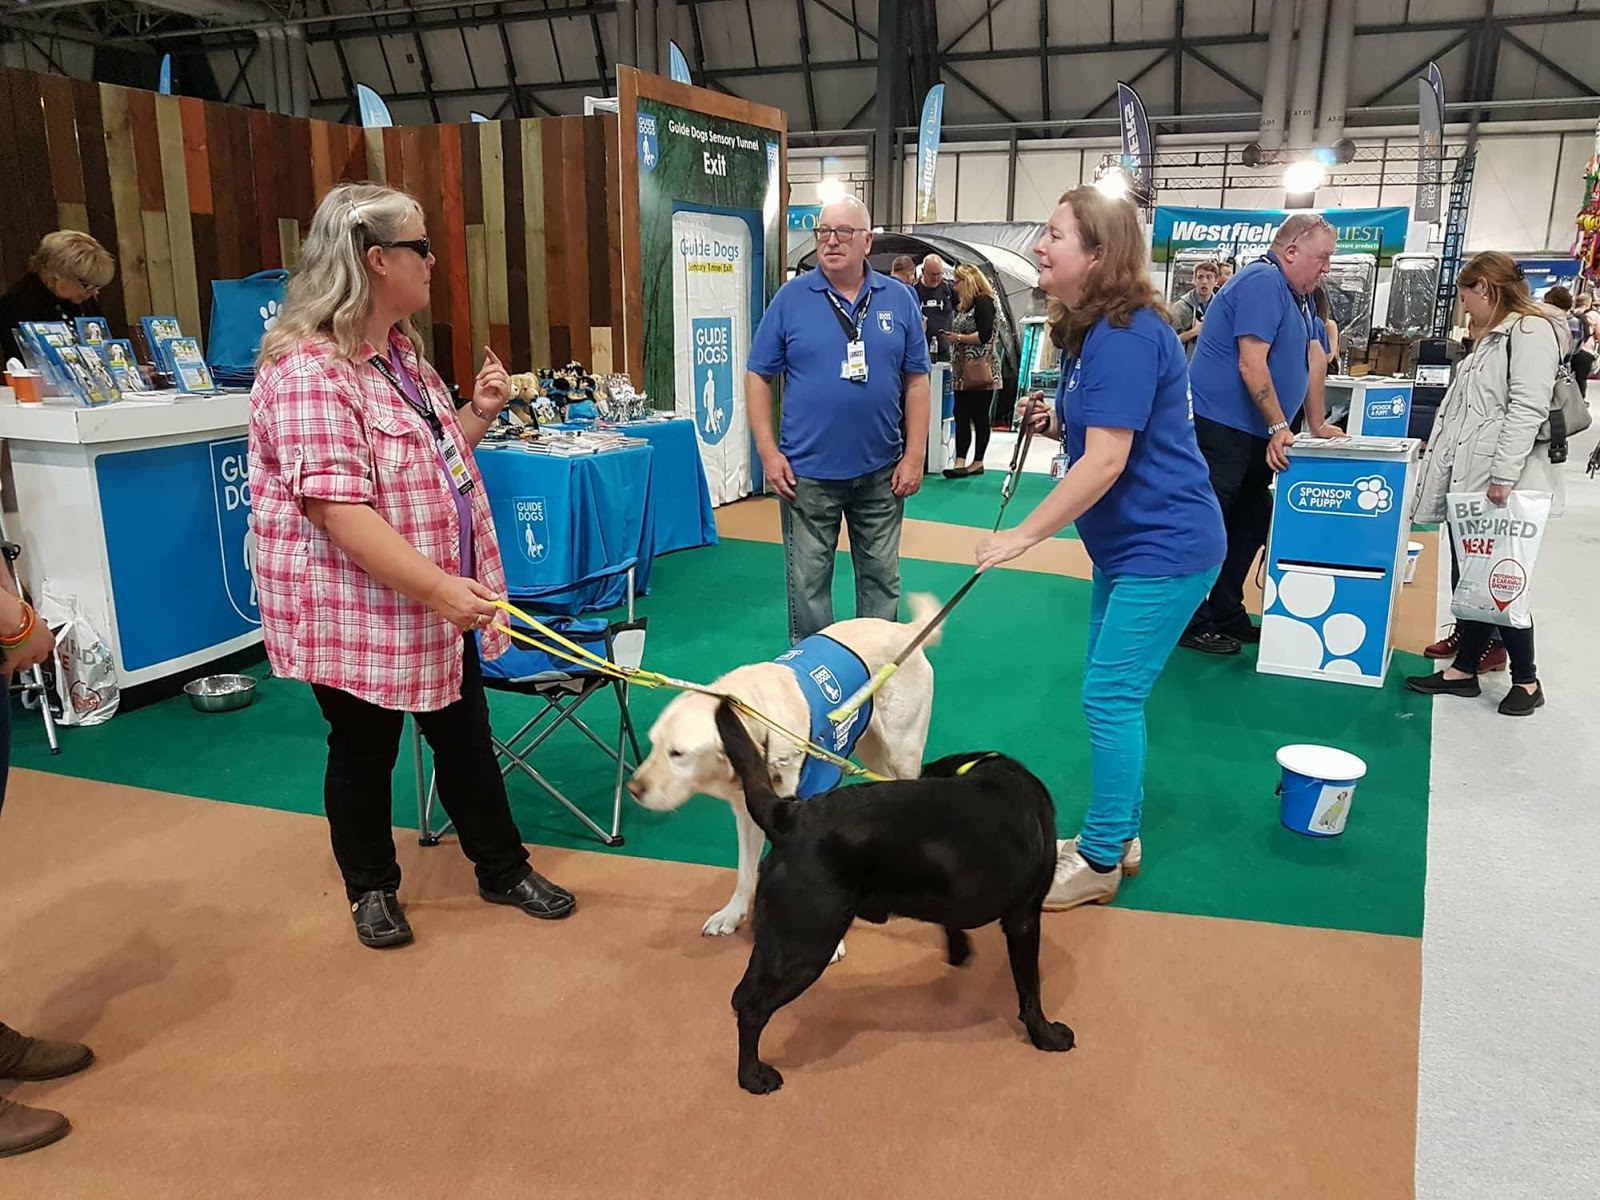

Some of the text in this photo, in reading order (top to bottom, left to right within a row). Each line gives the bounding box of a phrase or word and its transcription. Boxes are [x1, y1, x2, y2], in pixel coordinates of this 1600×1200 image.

[668, 119, 760, 151] Guide Dogs Sensory Tunnel
[703, 151, 727, 177] Exit
[1335, 226, 1385, 241] UEST
[680, 238, 739, 262] Guide Dogs
[696, 327, 728, 346] GUDE
[697, 346, 728, 365] DOGS
[1298, 496, 1343, 509] A PUPPY
[1299, 486, 1353, 500] SPONSOR
[516, 501, 543, 512] GUIDE
[1454, 501, 1483, 519] BE
[518, 511, 544, 522] DOGS
[1458, 518, 1538, 539] INSPIRED
[1461, 537, 1496, 556] HERE
